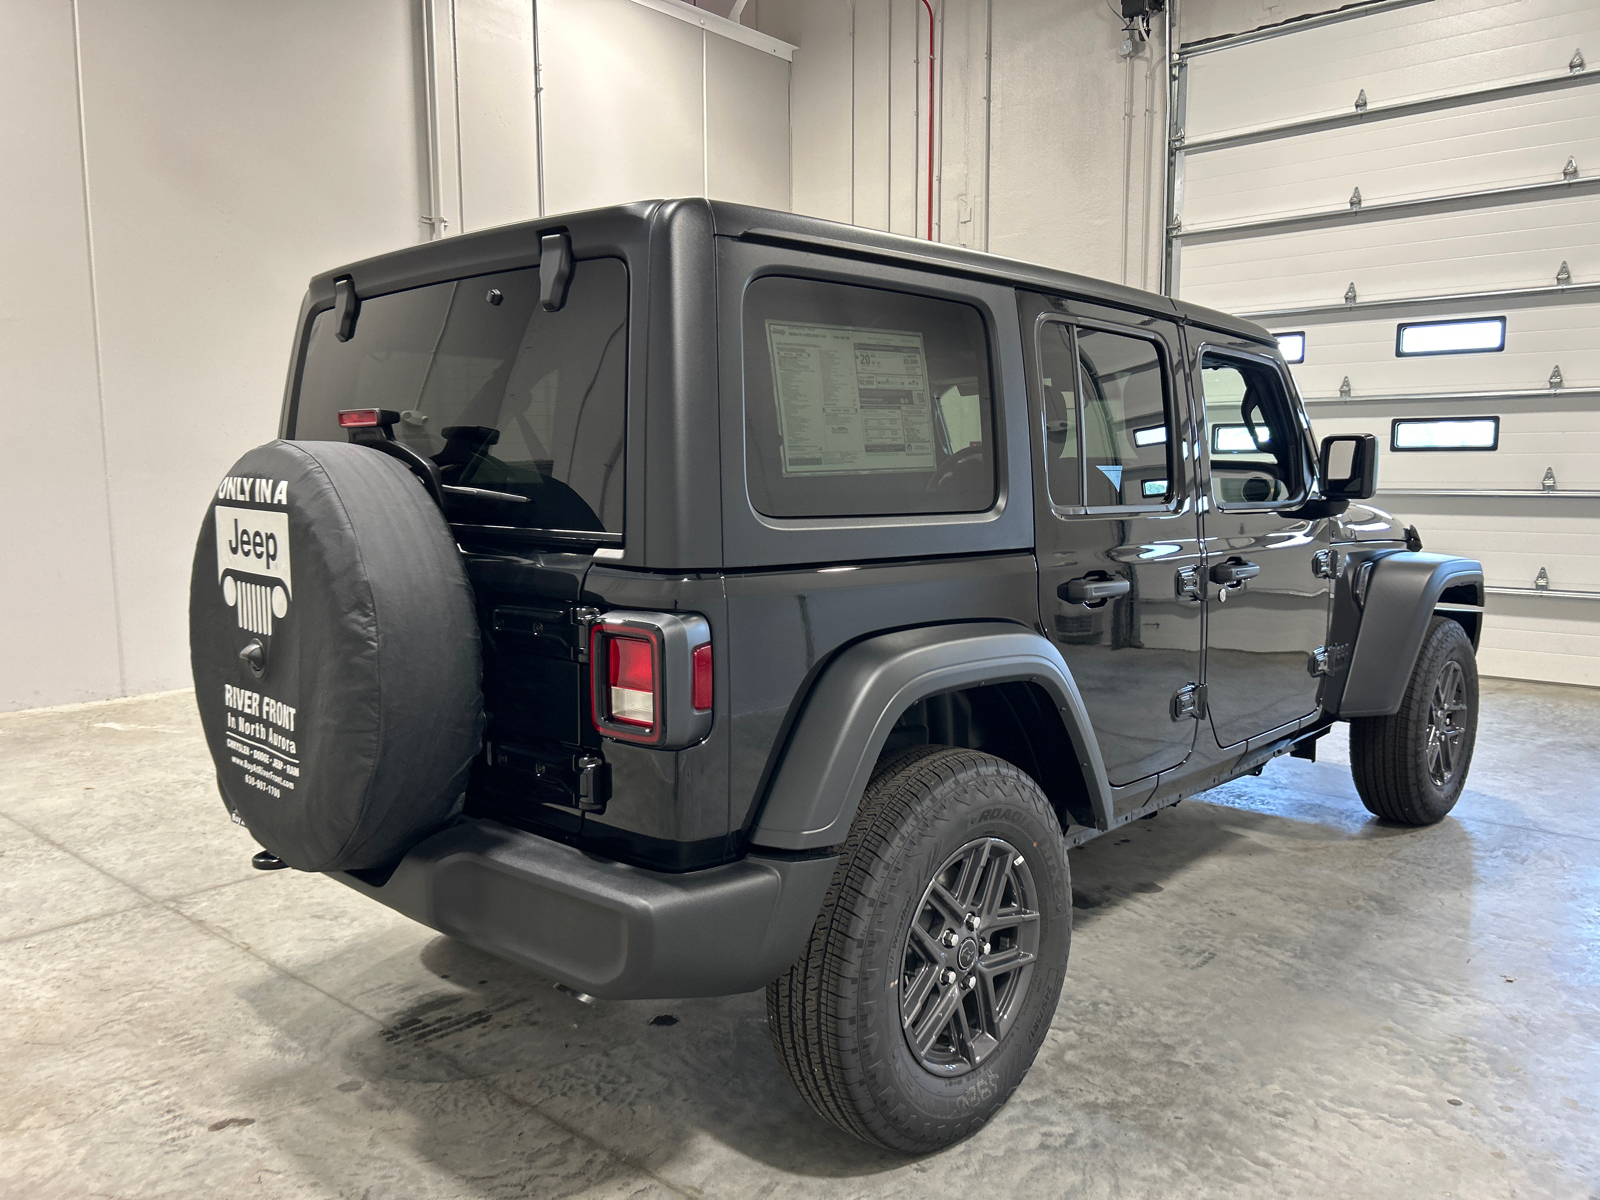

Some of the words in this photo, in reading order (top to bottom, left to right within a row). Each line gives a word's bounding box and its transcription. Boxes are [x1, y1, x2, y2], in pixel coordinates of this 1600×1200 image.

[218, 476, 254, 501] ONLY
[255, 478, 273, 504] IN
[273, 480, 289, 505] A
[229, 518, 278, 570] Jeep
[224, 683, 260, 717] RIVER
[262, 696, 296, 732] FRONT
[227, 712, 237, 729] In
[238, 716, 266, 740] North
[268, 727, 297, 754] Aurora
[226, 738, 250, 756] CHRYSLER
[252, 749, 270, 765] DODGE
[271, 758, 284, 771] JEEP
[286, 764, 300, 778] RAM
